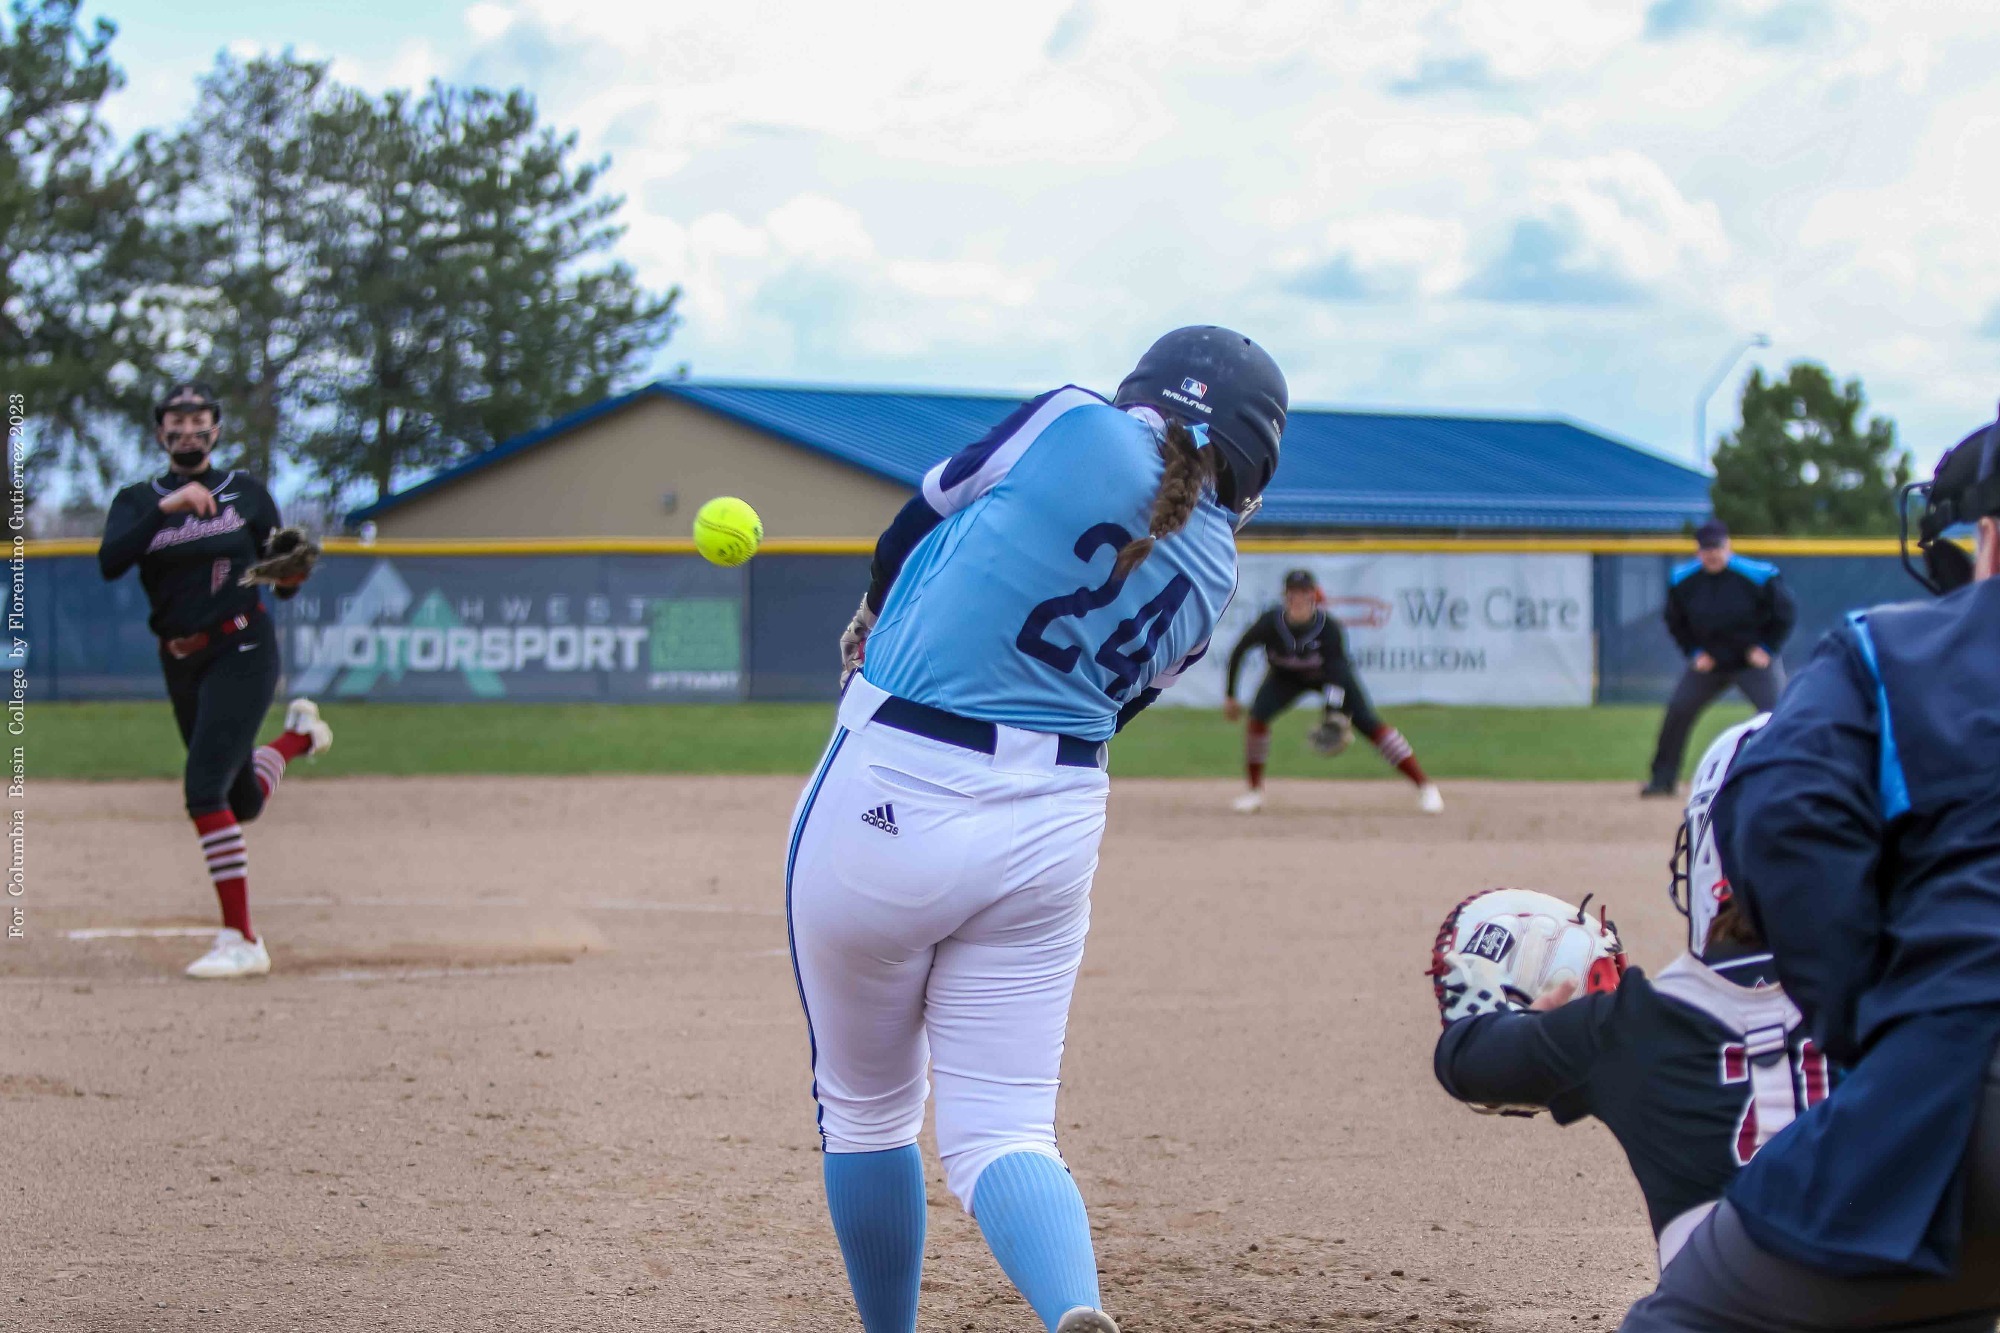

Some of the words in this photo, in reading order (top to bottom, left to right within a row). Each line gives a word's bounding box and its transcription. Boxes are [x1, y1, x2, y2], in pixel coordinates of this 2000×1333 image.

[1162, 388, 1213, 414] RAWLINGS
[1016, 522, 1192, 702] 24
[1404, 587, 1469, 631] We
[1484, 587, 1581, 632] Care
[295, 626, 648, 671] MOTORSPORT
[861, 812, 899, 835] adidas
